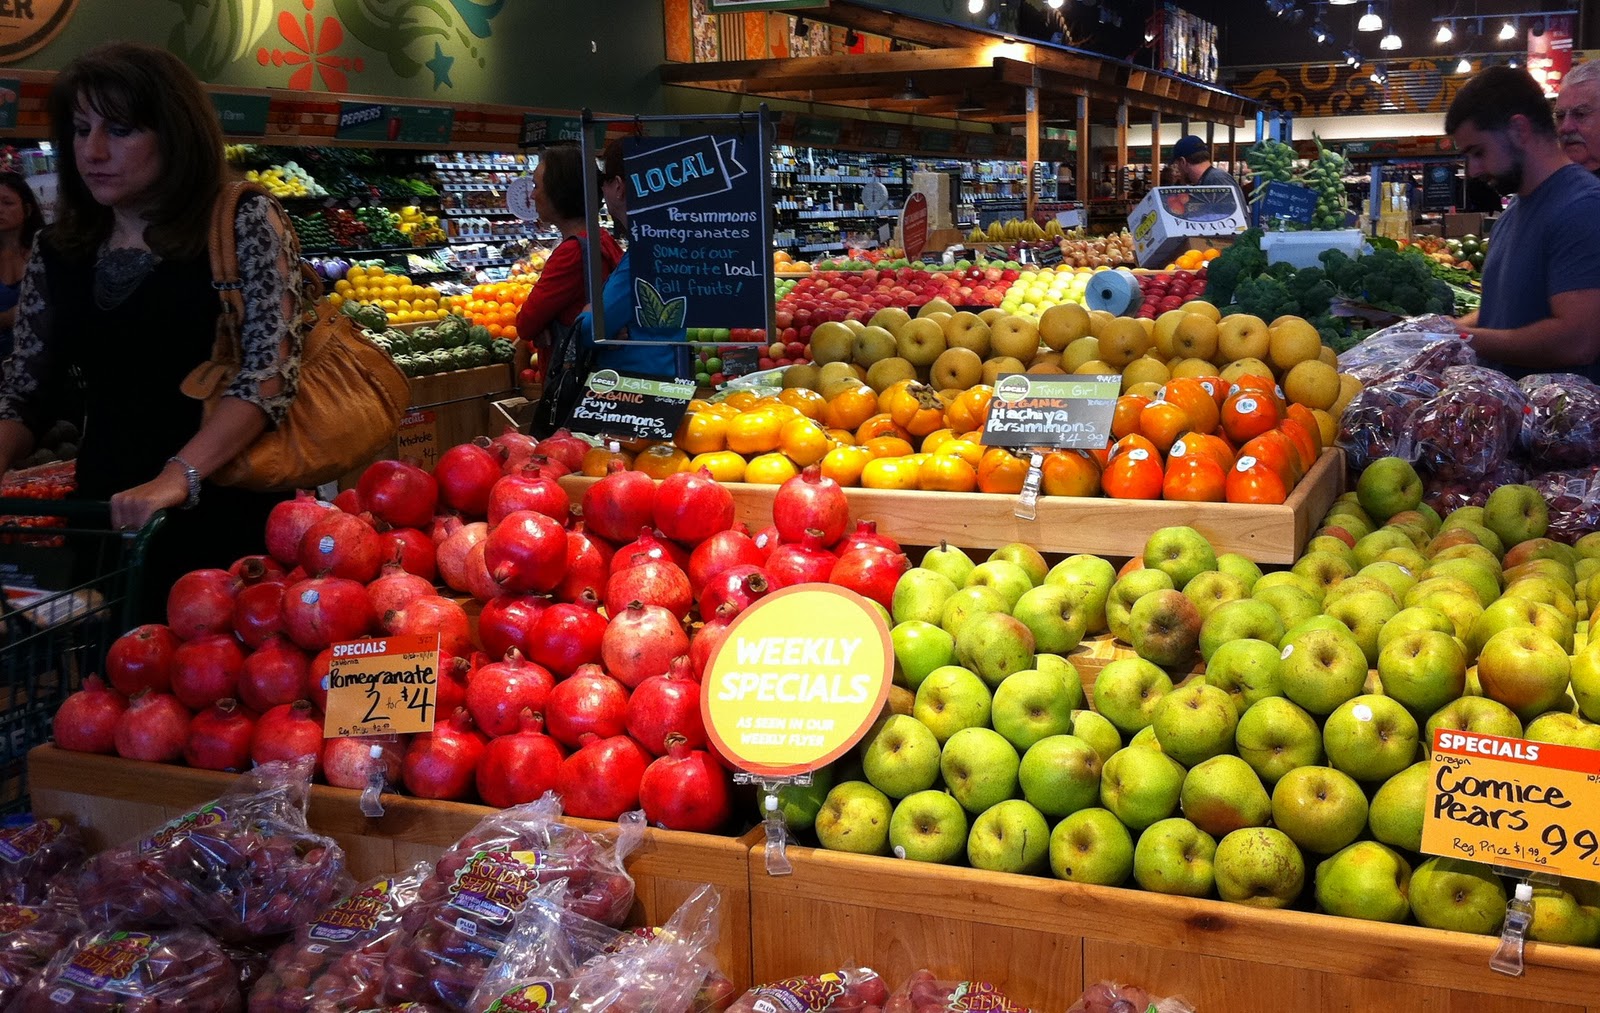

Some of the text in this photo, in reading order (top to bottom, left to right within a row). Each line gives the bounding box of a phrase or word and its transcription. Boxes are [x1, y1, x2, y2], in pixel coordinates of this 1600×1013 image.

[340, 106, 382, 126] PEPPERS
[630, 151, 714, 198] LOCAL
[667, 206, 757, 224] Persimmons
[1173, 218, 1237, 231] CUYAMA
[641, 224, 750, 243] Pomegranates
[690, 247, 706, 259] of
[708, 248, 740, 259] our
[654, 259, 721, 275] favorite
[655, 277, 743, 297] fall fruits!
[592, 377, 616, 386] LOCAL
[621, 379, 693, 396] Kaki Farms
[1000, 385, 1027, 393] LOCAL
[1037, 384, 1098, 396] Twin Girl
[581, 397, 617, 413] Fuyu
[585, 390, 644, 404] ORGANIC
[993, 399, 1068, 409] ORGANIC
[573, 406, 665, 428] Persimmons
[991, 408, 1069, 425] Hachiya
[986, 419, 1096, 433] Persimmons
[333, 641, 387, 657] SPECIALS
[736, 636, 862, 666] WEEKLY
[330, 664, 436, 692] Pomegranate
[718, 671, 871, 705] SPECIALS
[361, 686, 434, 723] 2 for $4
[736, 717, 834, 731] AS SEEN IN OUR
[741, 733, 825, 748] WEEKLY FLYER
[1438, 733, 1540, 761] SPECIALS
[1435, 754, 1471, 769] Oregon
[1435, 765, 1572, 809] Comice
[1587, 774, 1600, 784] 10/
[1433, 793, 1529, 831] Pears
[1479, 840, 1510, 856] Price
[1541, 824, 1599, 860] 99
[471, 858, 535, 893] HOLIDAY
[453, 875, 527, 910] SEEDLESS
